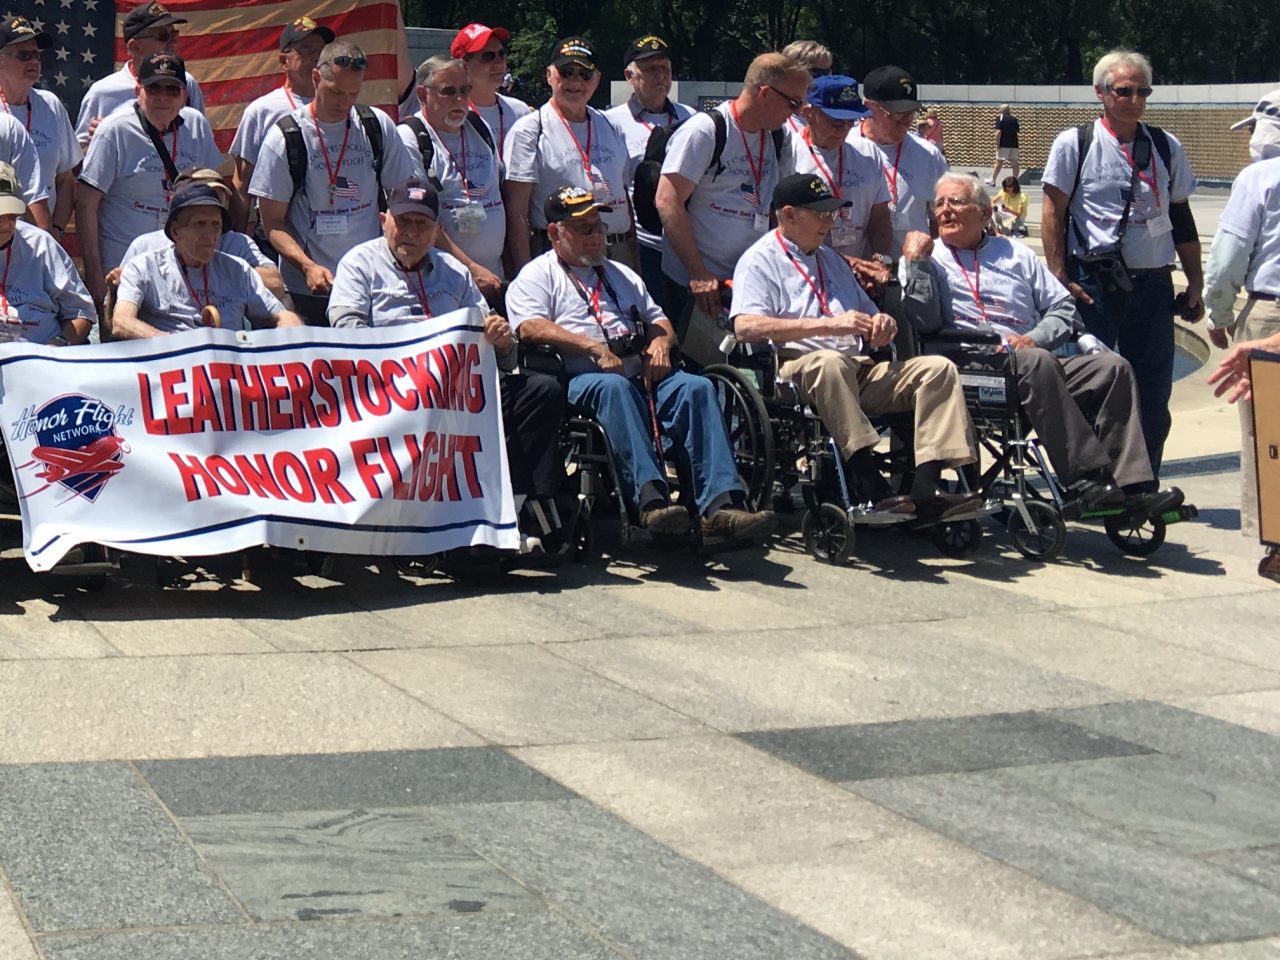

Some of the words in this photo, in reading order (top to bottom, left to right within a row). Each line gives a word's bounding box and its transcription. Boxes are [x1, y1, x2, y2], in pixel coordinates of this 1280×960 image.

[11, 404, 69, 442] Honor
[74, 399, 135, 432] Flight
[138, 343, 486, 436] LEATHERSTOCKING
[167, 448, 356, 504] HONOR
[350, 431, 484, 503] FLIGHT
